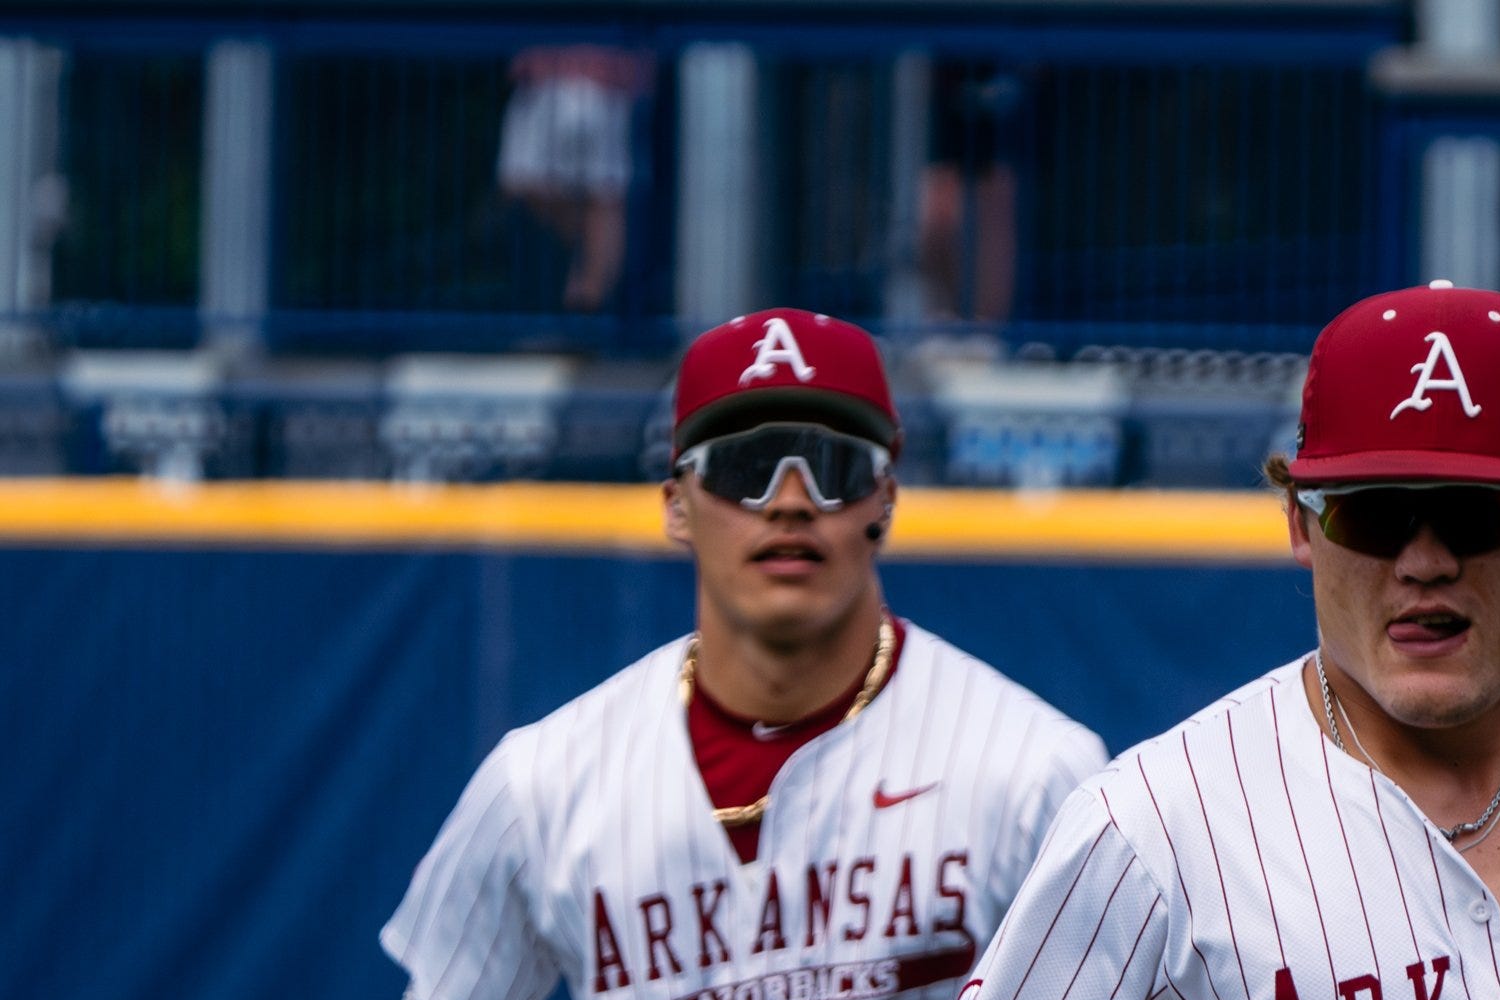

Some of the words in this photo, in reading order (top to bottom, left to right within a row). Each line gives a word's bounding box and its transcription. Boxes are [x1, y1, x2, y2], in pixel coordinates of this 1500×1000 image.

[738, 317, 817, 388] A
[1389, 331, 1482, 420] A
[593, 853, 969, 992] ARKANSAS
